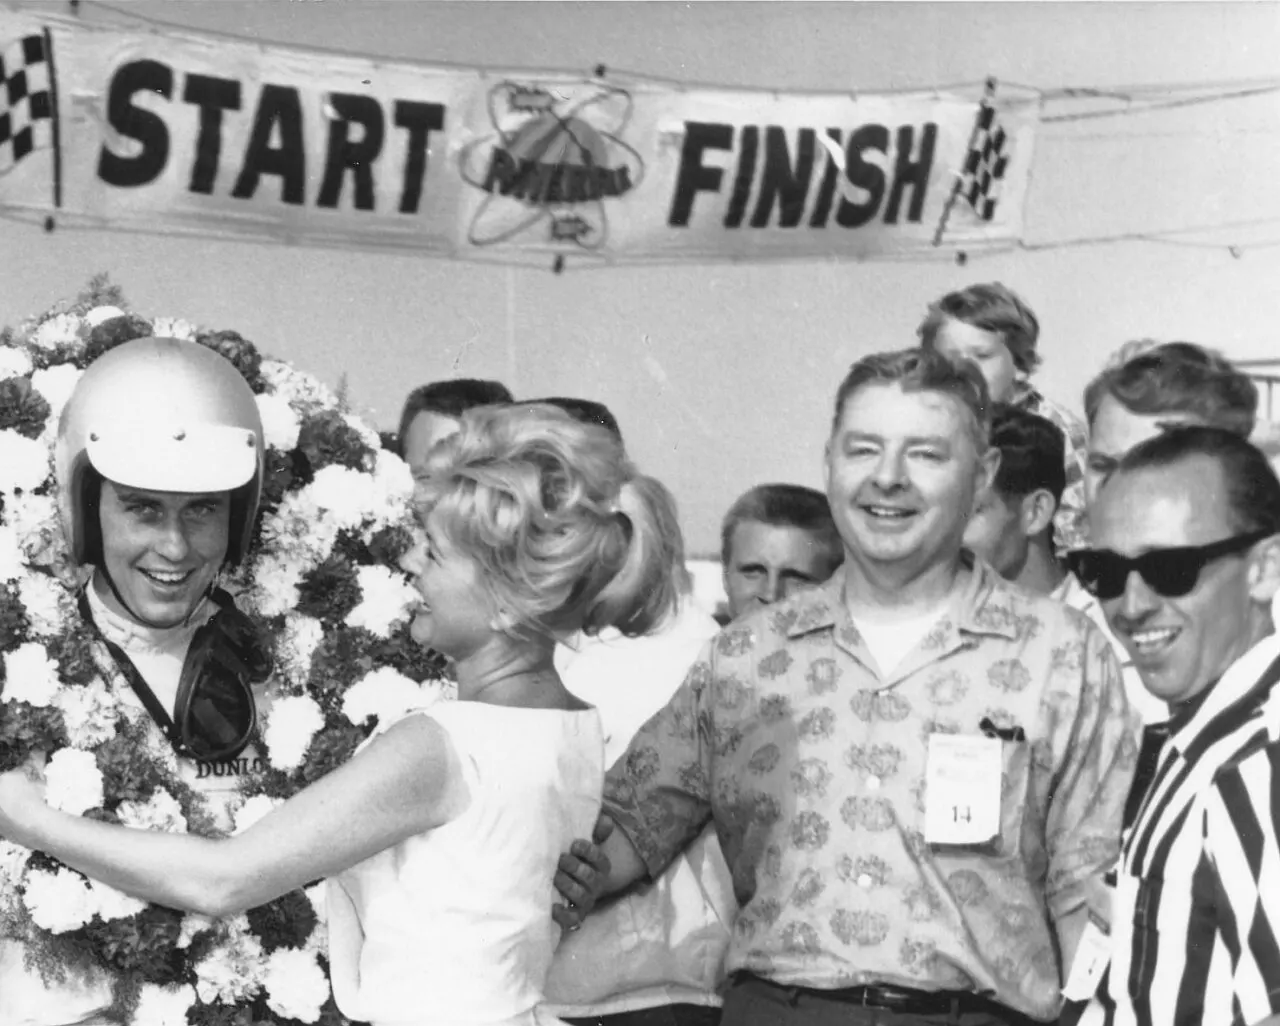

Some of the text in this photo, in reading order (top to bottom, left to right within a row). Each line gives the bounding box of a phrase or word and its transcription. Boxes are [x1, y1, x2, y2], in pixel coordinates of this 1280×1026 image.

[97, 59, 446, 213] START
[667, 120, 938, 229] FINISH
[195, 757, 263, 779] DUNLO
[952, 805, 972, 824] 14
